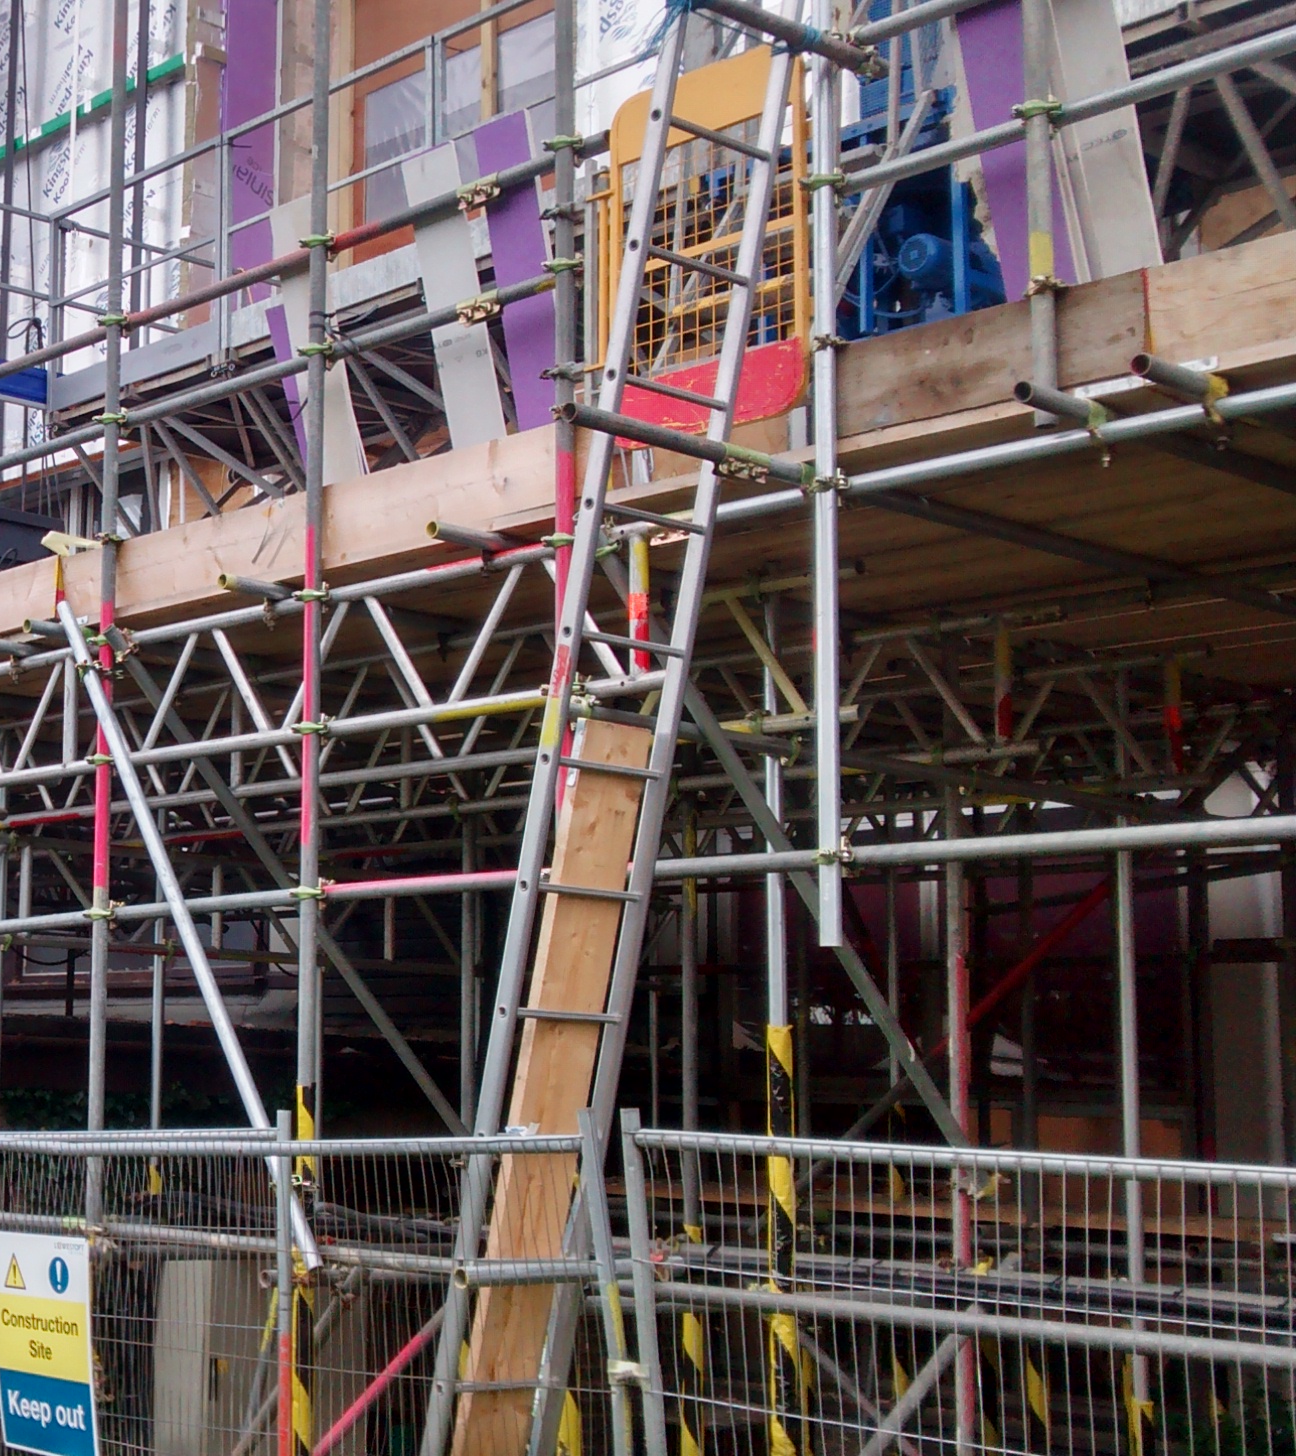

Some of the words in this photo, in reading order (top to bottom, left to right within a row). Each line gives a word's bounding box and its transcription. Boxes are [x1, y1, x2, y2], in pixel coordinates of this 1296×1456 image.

[42, 145, 72, 198] Kingsp
[1, 1308, 79, 1336] Construction
[29, 1340, 52, 1361] Site
[7, 1389, 52, 1429] Keep
[55, 1404, 86, 1432] out
